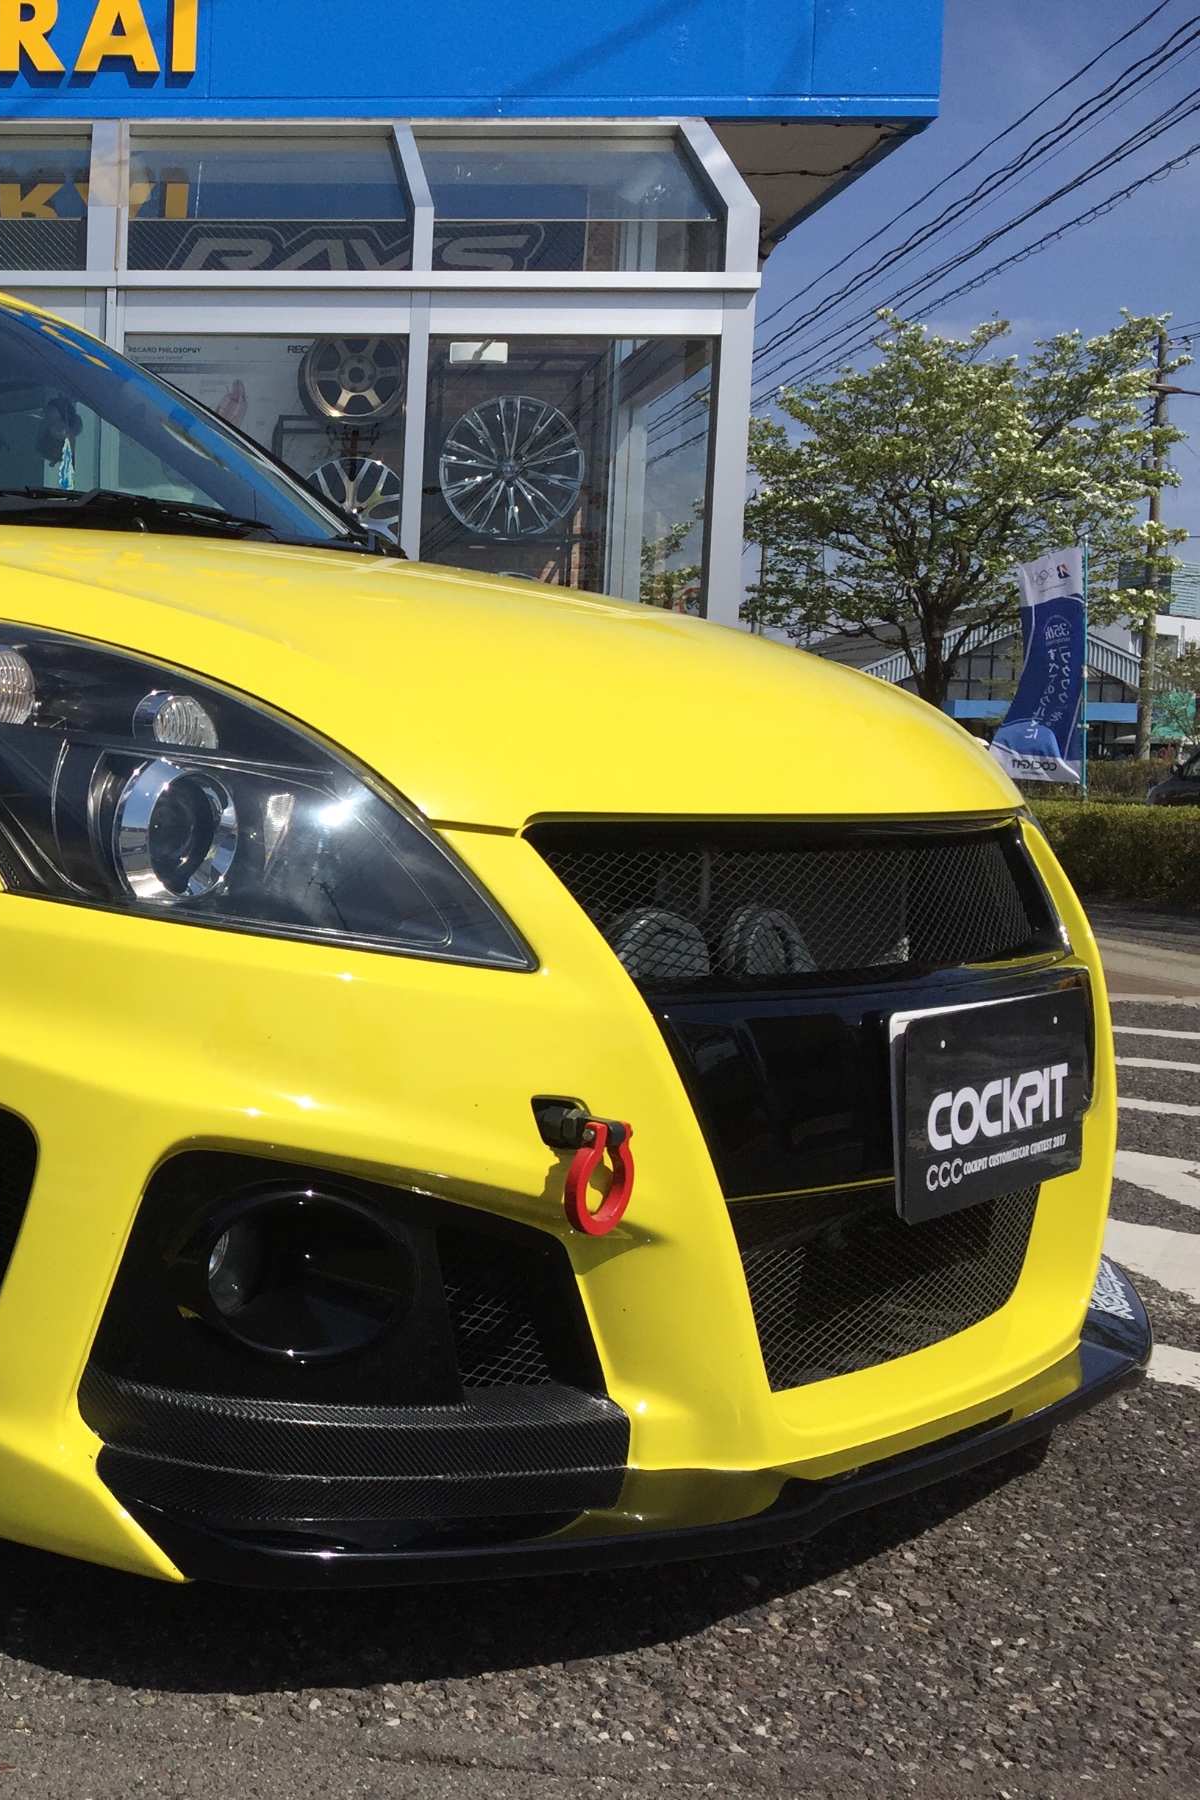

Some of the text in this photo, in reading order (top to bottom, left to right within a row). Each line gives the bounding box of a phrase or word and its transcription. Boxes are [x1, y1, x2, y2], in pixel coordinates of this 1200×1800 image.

[128, 346, 156, 354] RECARO
[928, 1063, 1068, 1151] COCKPIT
[926, 1158, 963, 1192] CCC
[963, 1156, 988, 1175] COCKPIT
[1030, 1138, 1052, 1157] CONTEST
[1052, 1133, 1067, 1149] 2017
